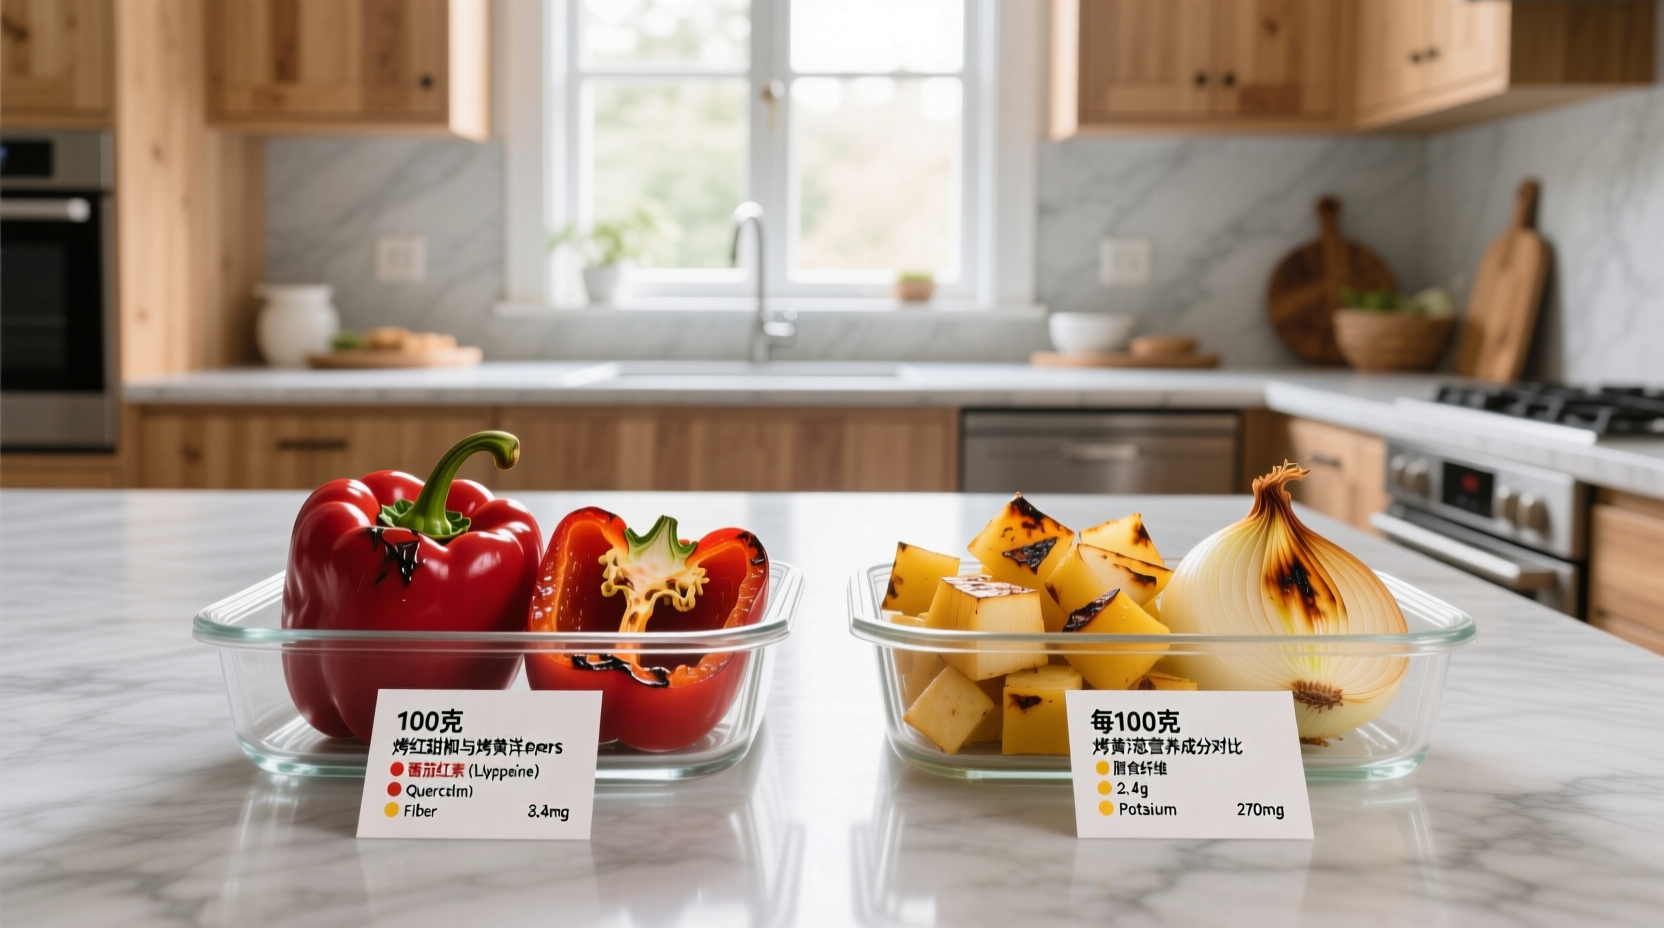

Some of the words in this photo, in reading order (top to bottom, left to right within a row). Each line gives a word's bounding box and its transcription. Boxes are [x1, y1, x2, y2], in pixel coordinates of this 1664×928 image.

[397, 707, 463, 734] 100克
[1090, 708, 1181, 734] 每100克
[1237, 802, 1285, 820] 270mg
